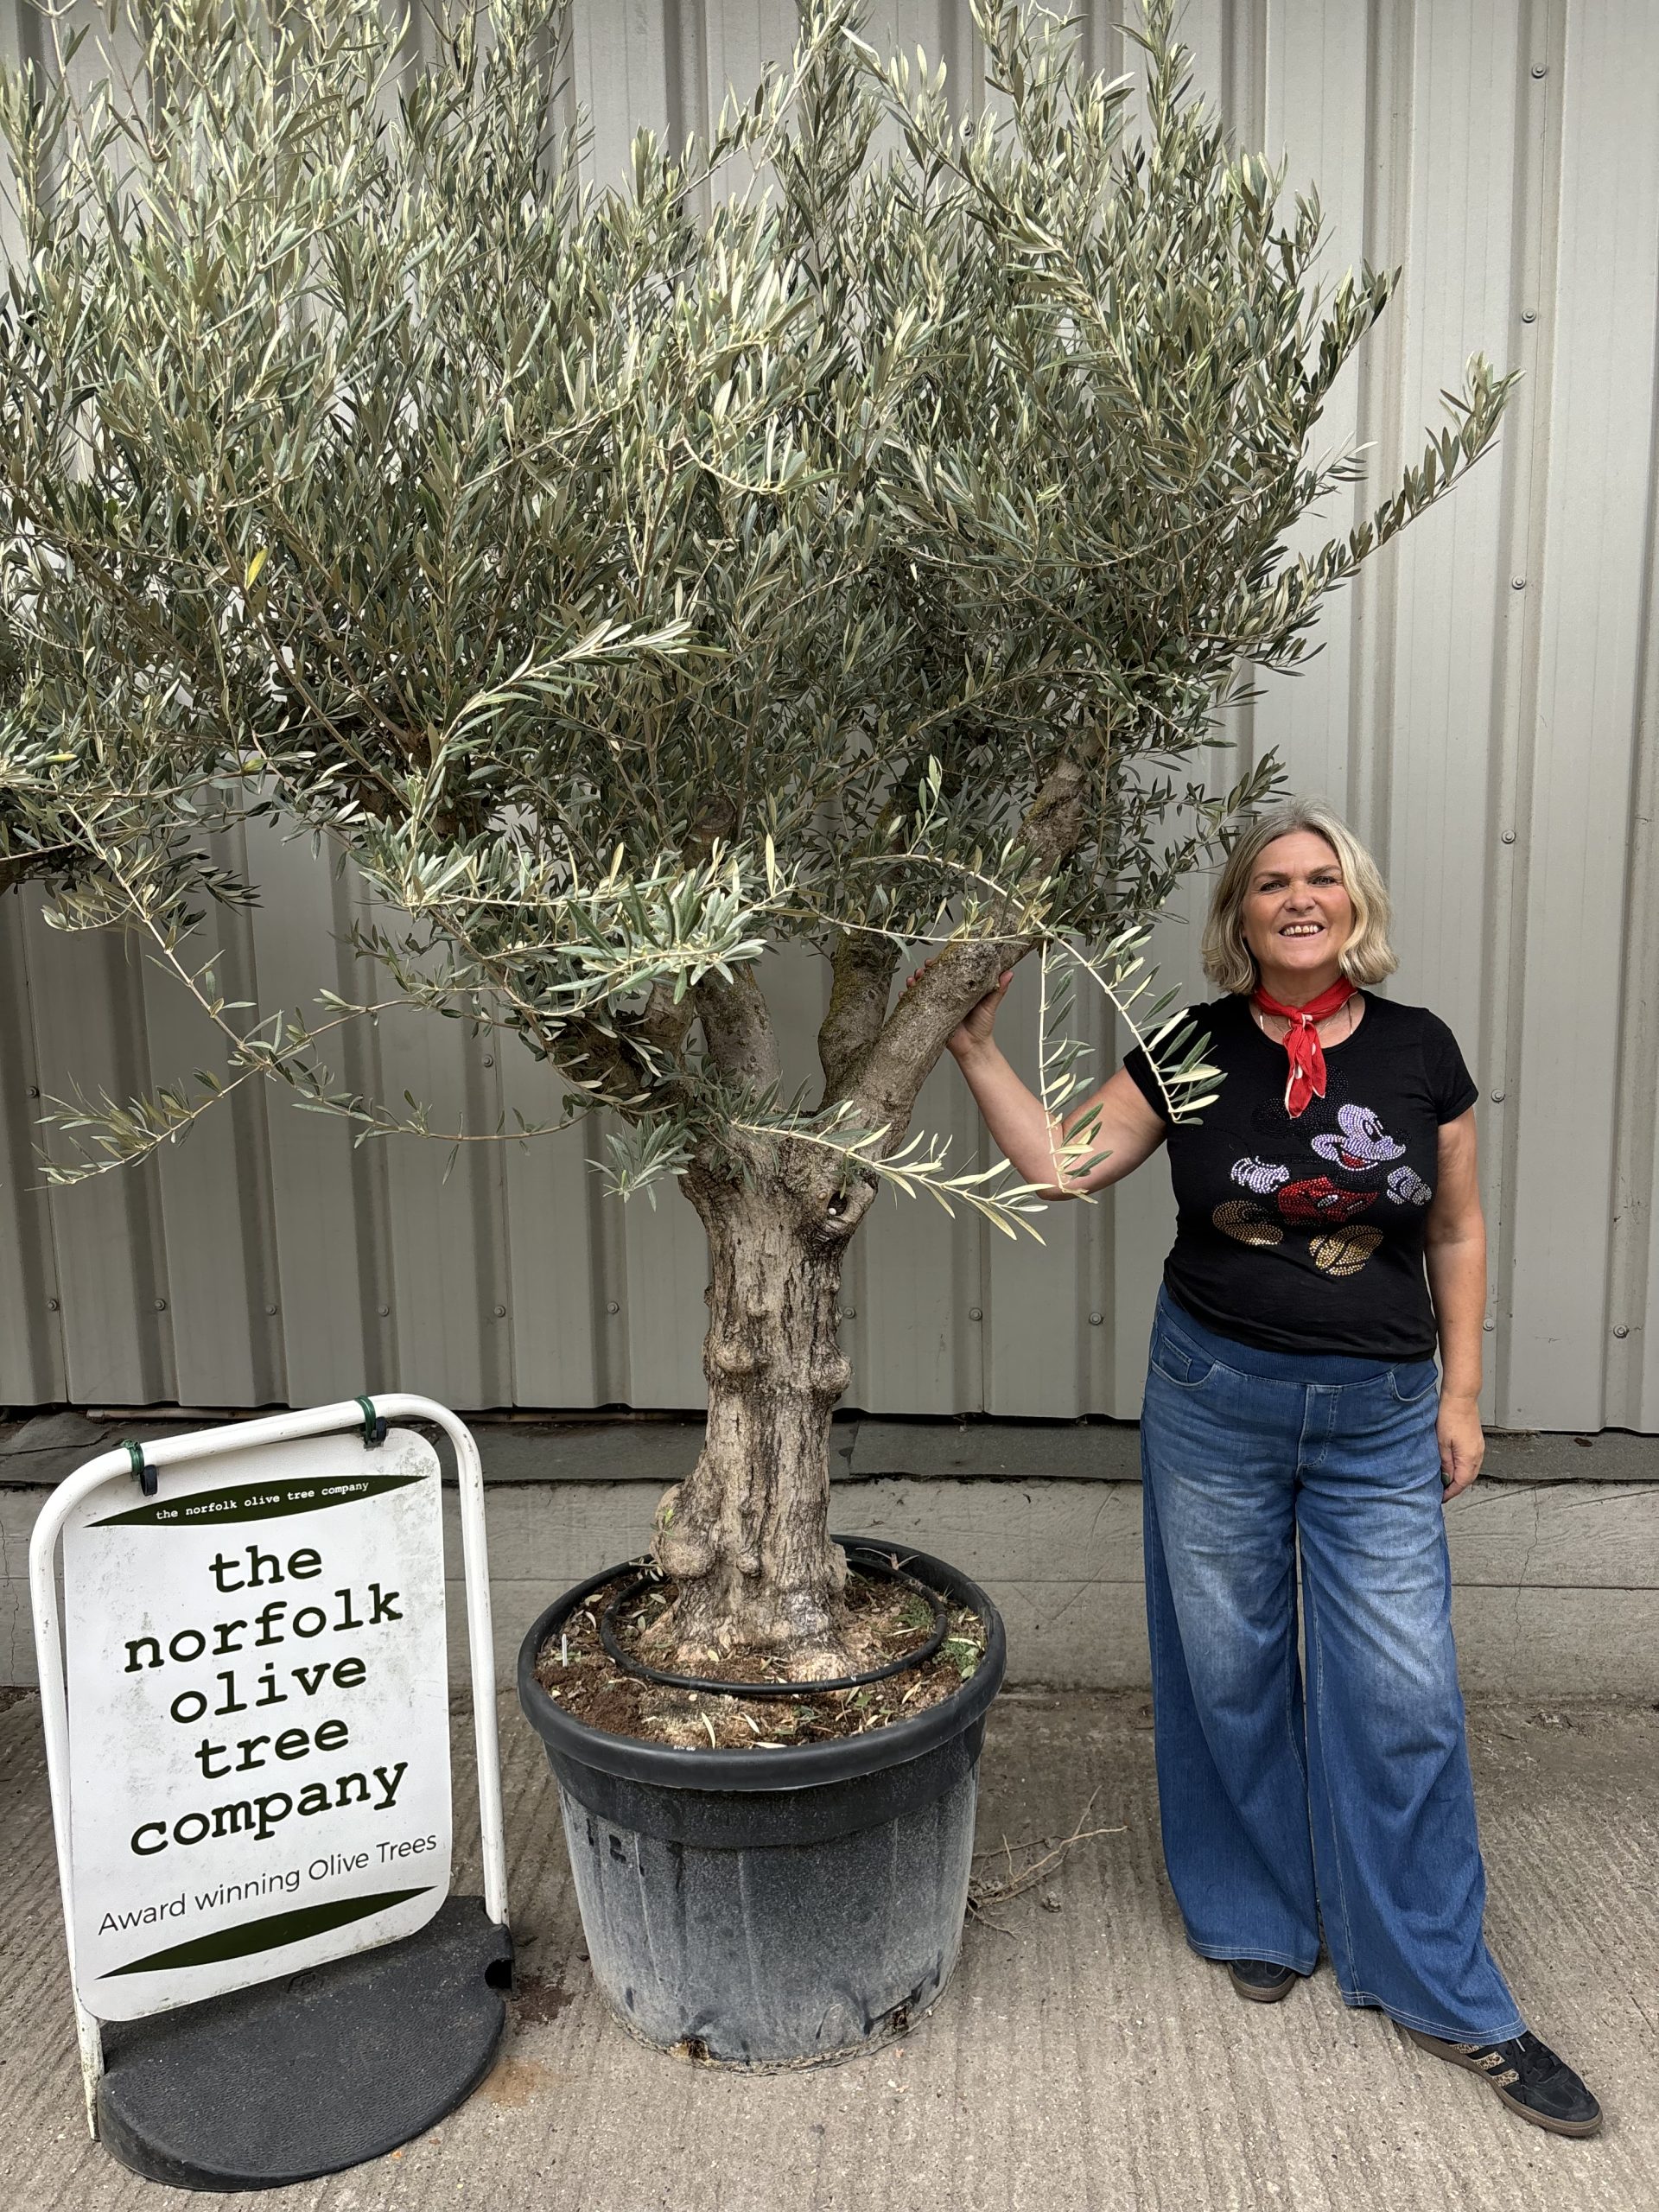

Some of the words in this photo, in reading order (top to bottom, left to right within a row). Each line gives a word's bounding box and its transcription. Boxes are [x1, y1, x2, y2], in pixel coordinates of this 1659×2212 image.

[156, 1510, 179, 1520] the
[185, 1500, 238, 1516] norfolk
[244, 1495, 280, 1507] olive
[287, 1491, 315, 1501] tree
[321, 1482, 369, 1496] company
[208, 1544, 322, 1593] the
[124, 1583, 404, 1673] norfolk
[170, 1657, 366, 1724] olive
[194, 1719, 349, 1779] tree
[130, 1762, 409, 1856] company
[98, 1893, 186, 1936] Award
[195, 1870, 300, 1910] winning
[308, 1853, 369, 1880] Olive
[376, 1834, 437, 1863] Trees
